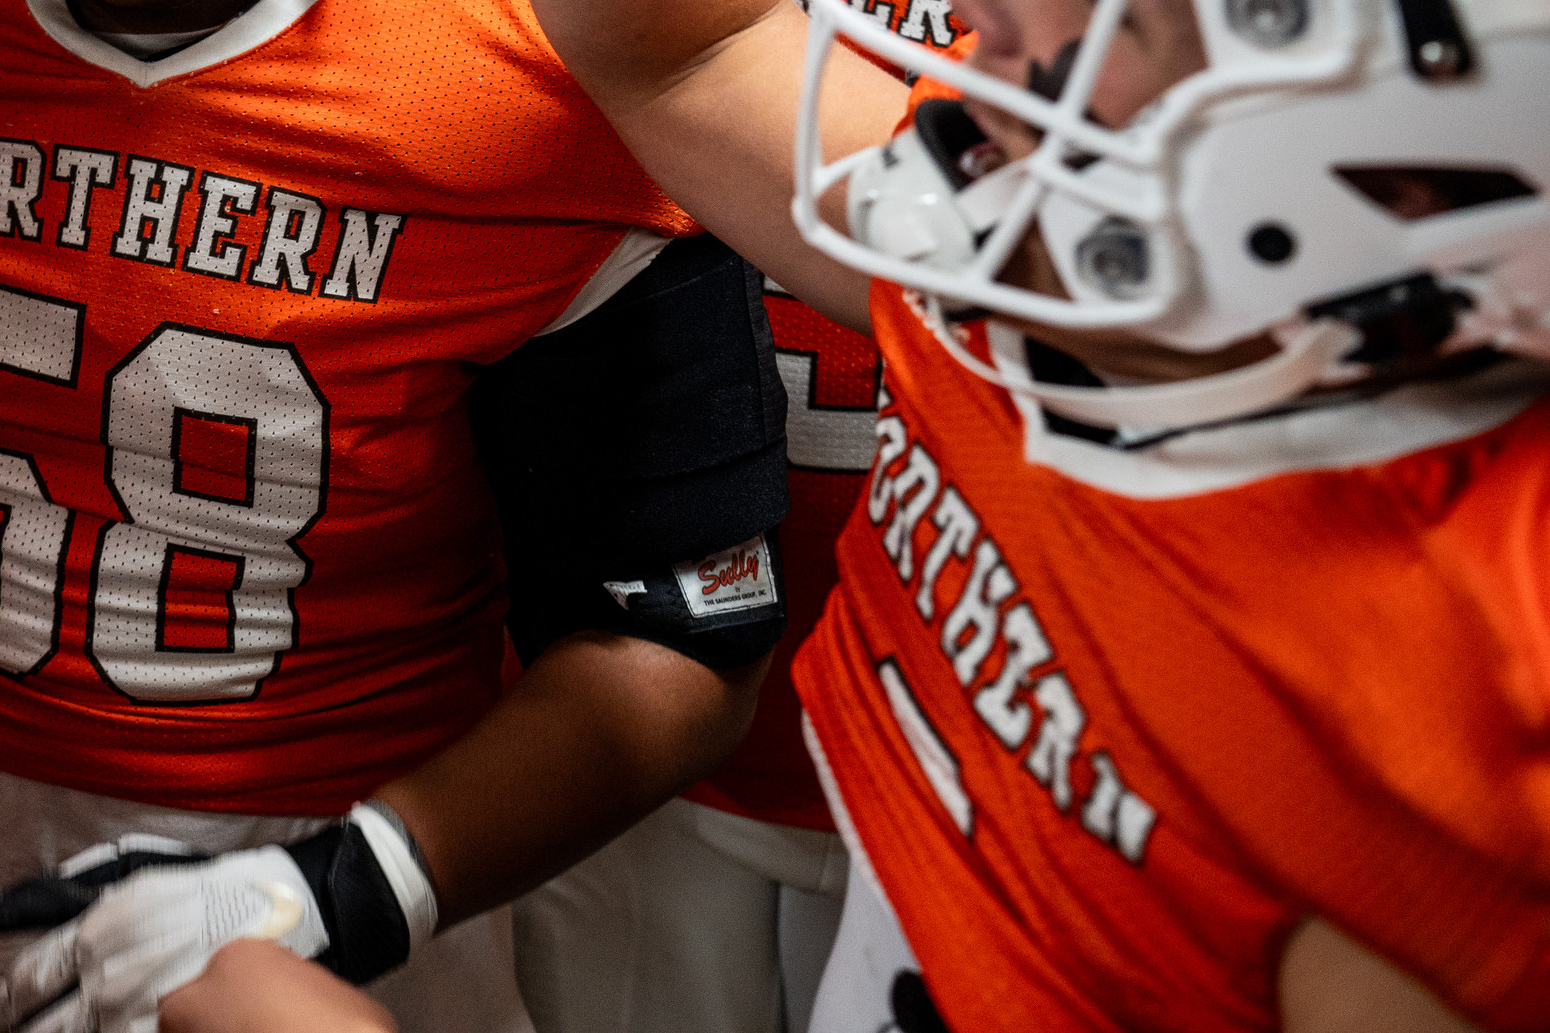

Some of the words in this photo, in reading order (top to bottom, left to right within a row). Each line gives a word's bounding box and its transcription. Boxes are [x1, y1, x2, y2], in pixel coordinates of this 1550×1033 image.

[698, 549, 759, 596] Sully
[704, 598, 715, 606] THE
[715, 594, 741, 604] SAUNDERS
